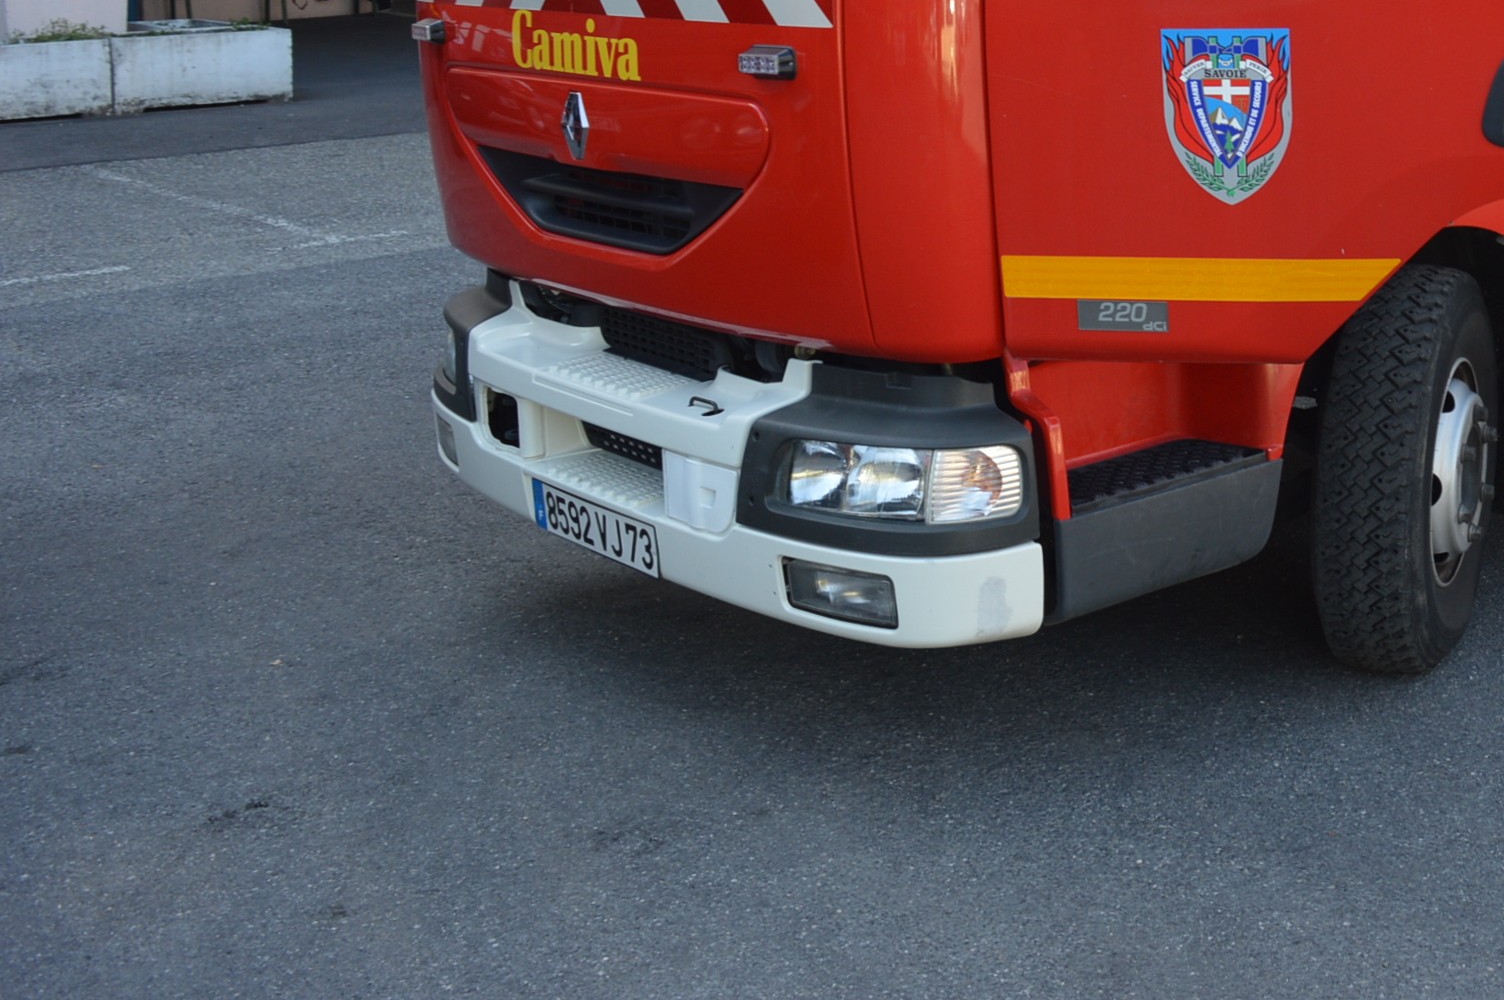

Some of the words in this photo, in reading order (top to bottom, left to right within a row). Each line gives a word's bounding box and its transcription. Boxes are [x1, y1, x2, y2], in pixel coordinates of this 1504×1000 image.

[512, 9, 642, 81] Camiva
[1204, 69, 1247, 78] SAVOIE
[1098, 302, 1147, 322] 220
